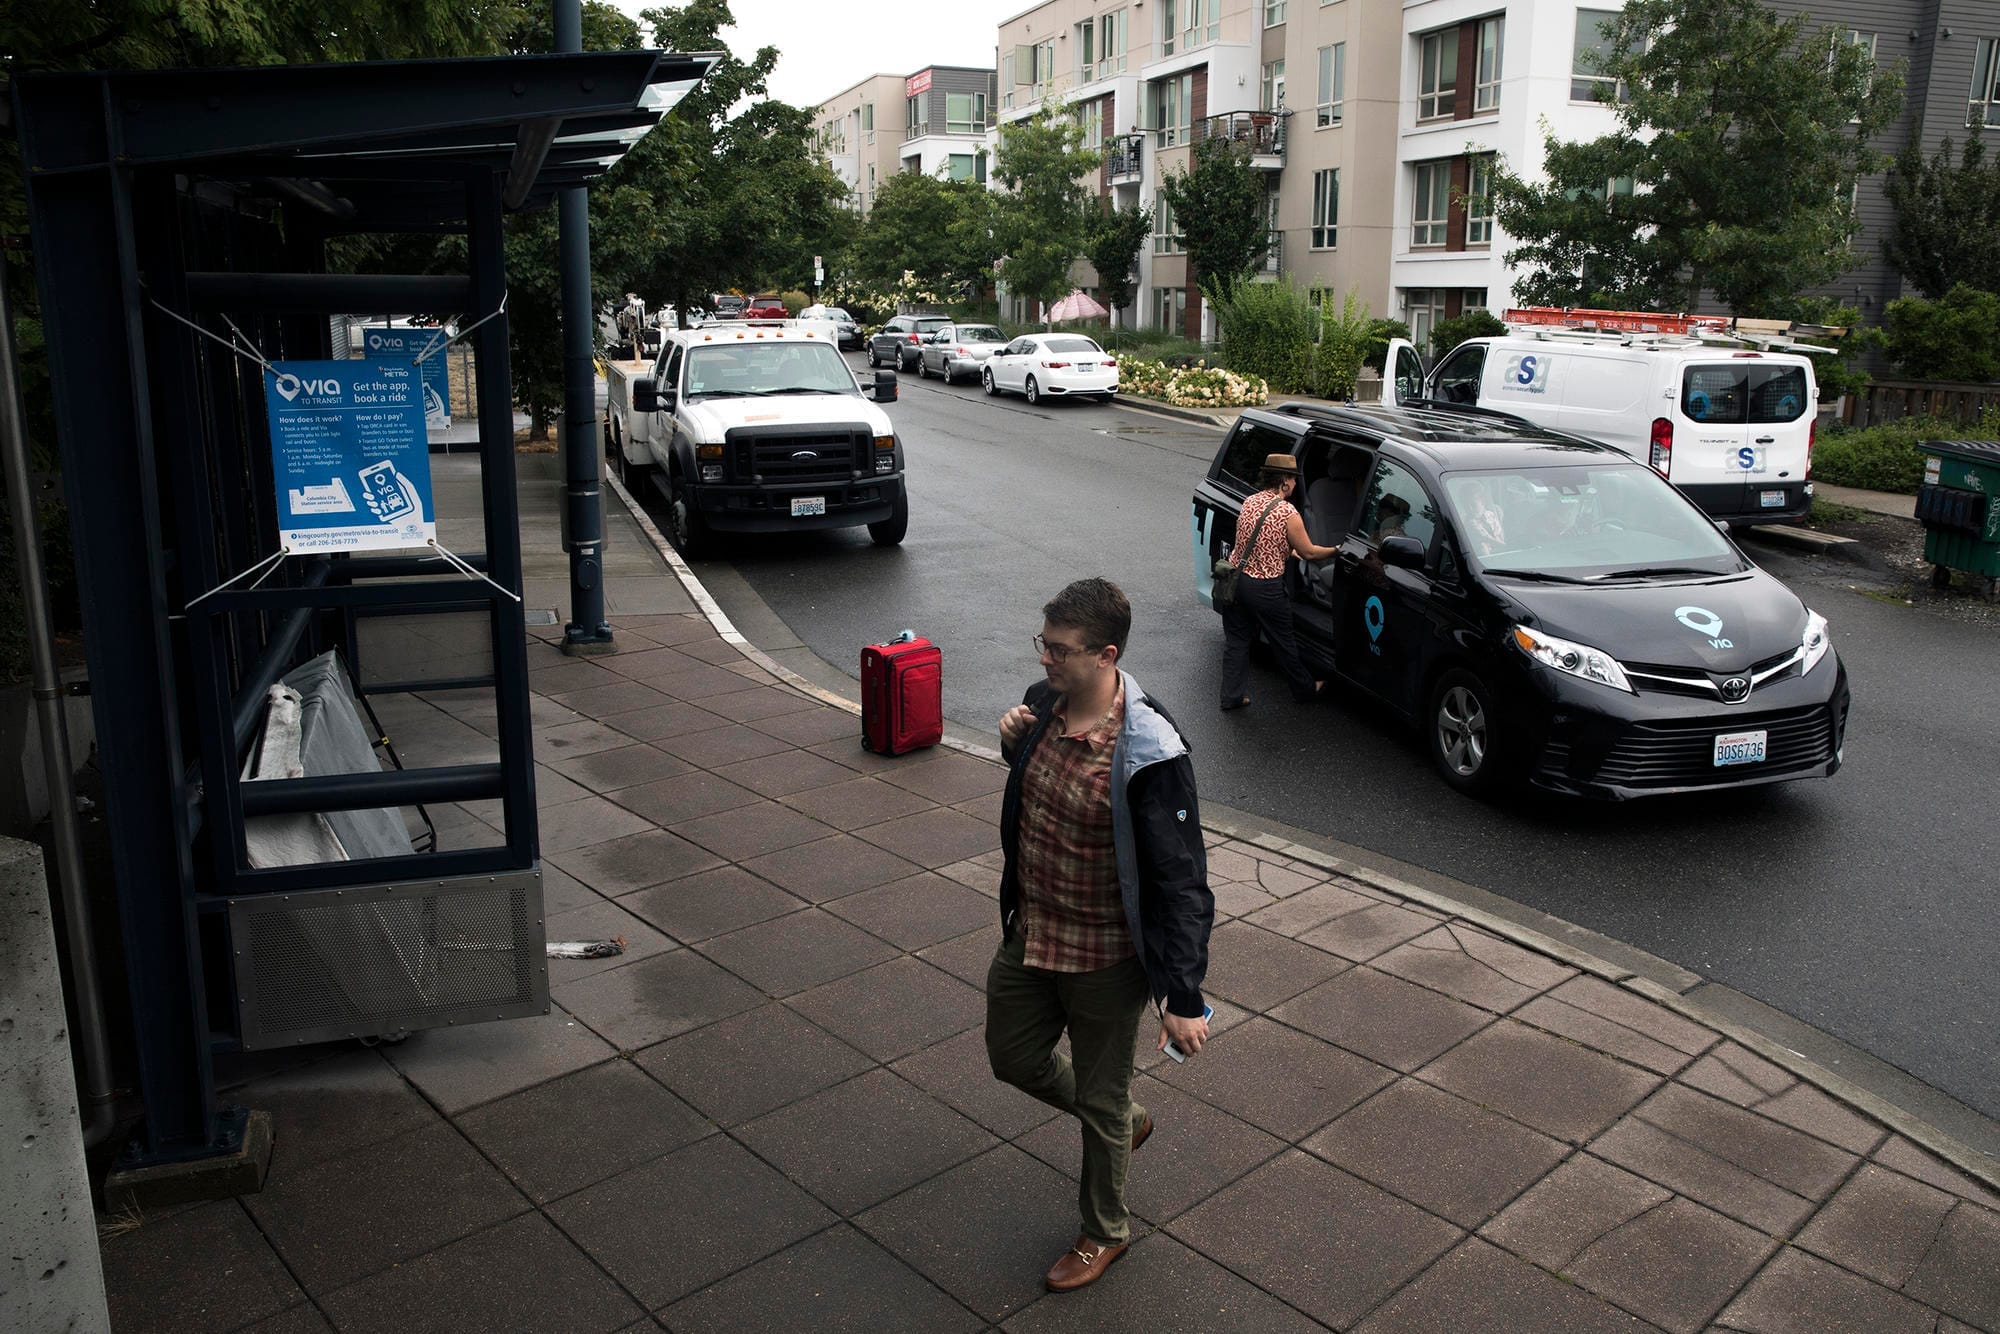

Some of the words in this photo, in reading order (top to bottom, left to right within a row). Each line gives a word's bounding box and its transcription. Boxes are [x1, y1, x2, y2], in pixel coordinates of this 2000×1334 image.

[353, 382, 370, 392] Get
[372, 381, 388, 391] the
[389, 382, 410, 392] app,
[354, 393, 378, 403] book
[388, 392, 407, 402] ride
[388, 412, 404, 421] pay?
